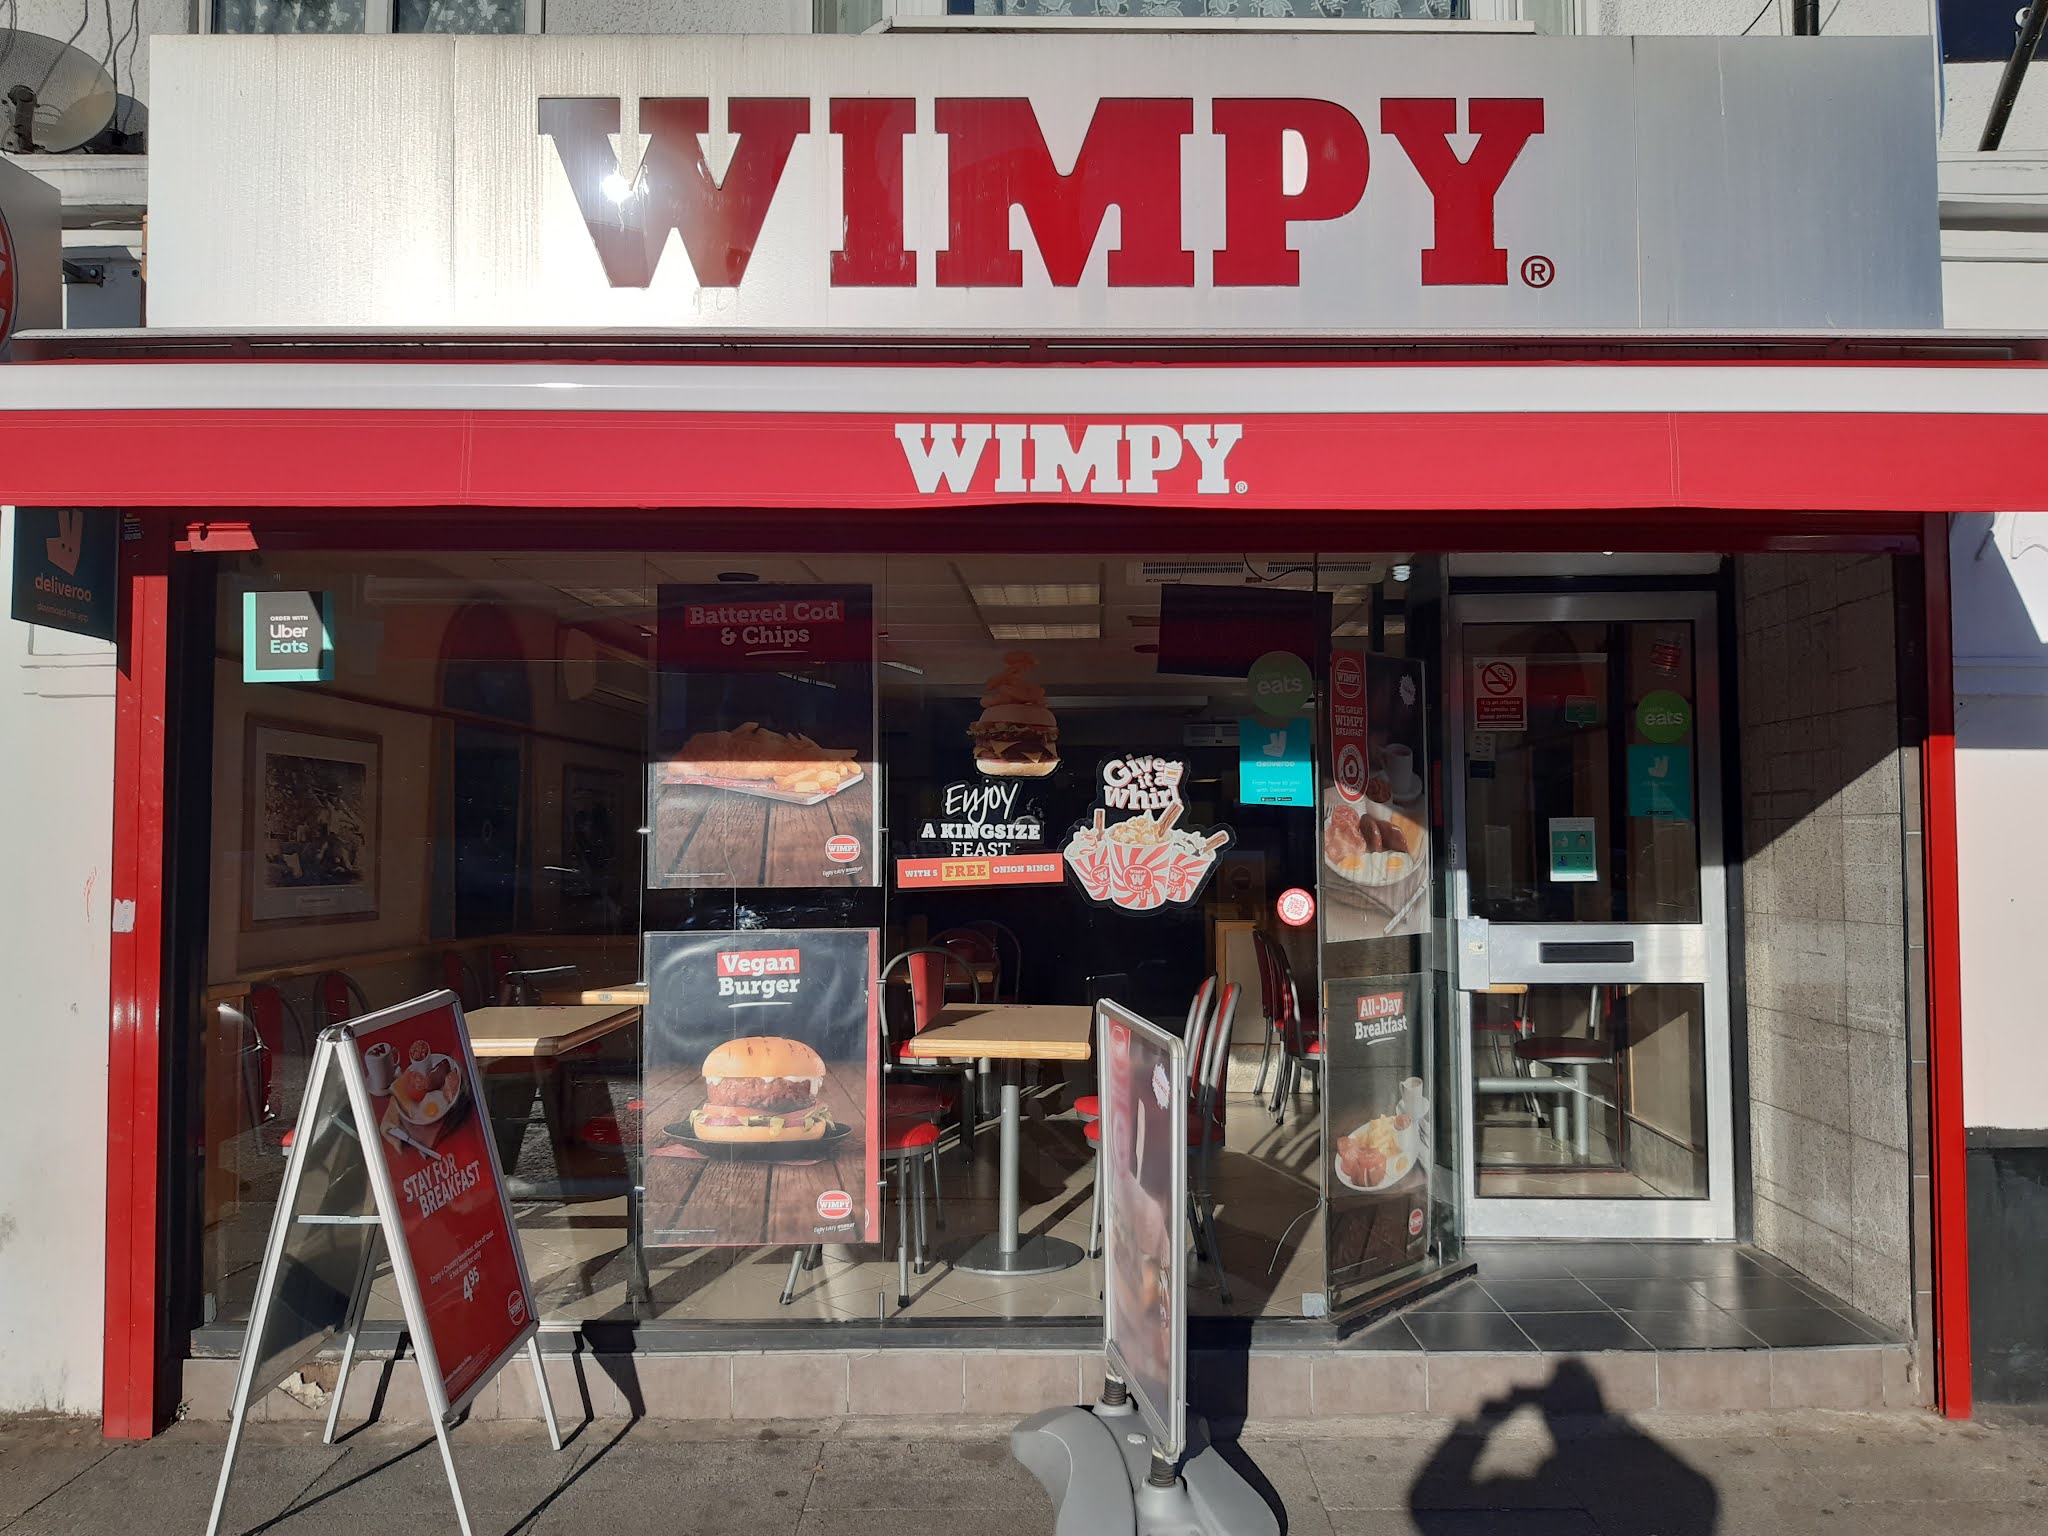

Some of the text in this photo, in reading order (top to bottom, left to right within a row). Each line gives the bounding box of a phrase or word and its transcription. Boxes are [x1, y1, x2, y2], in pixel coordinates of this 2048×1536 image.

[34, 572, 92, 602] deliveroo
[690, 602, 839, 625] Battered Cod
[270, 624, 308, 638] Uber
[721, 625, 810, 647] & Chips
[270, 640, 308, 654] Eats
[1257, 675, 1303, 695] eats
[1335, 705, 1364, 714] THE GREAT
[1644, 712, 1683, 726] eats
[1335, 715, 1364, 727] WIMPY
[1335, 728, 1364, 737] BREAKFAST
[1103, 754, 1166, 788] Give
[1138, 772, 1165, 790] it a
[945, 779, 1020, 824] Enjoy
[921, 823, 1041, 840] A KINGSIZE
[951, 842, 1011, 857] FEAST
[905, 869, 931, 878] WITH
[945, 865, 987, 878] FREE
[993, 865, 1025, 874] ONION
[1026, 863, 1055, 873] RINGS
[722, 953, 796, 976] Vegan
[718, 977, 800, 999] Burger
[1360, 996, 1402, 1017] All-Day
[1355, 1016, 1407, 1040] Breakfast
[403, 1152, 458, 1203] STAY FOR
[419, 1160, 481, 1219] BREAKFAST
[820, 1201, 849, 1209] WIMPY
